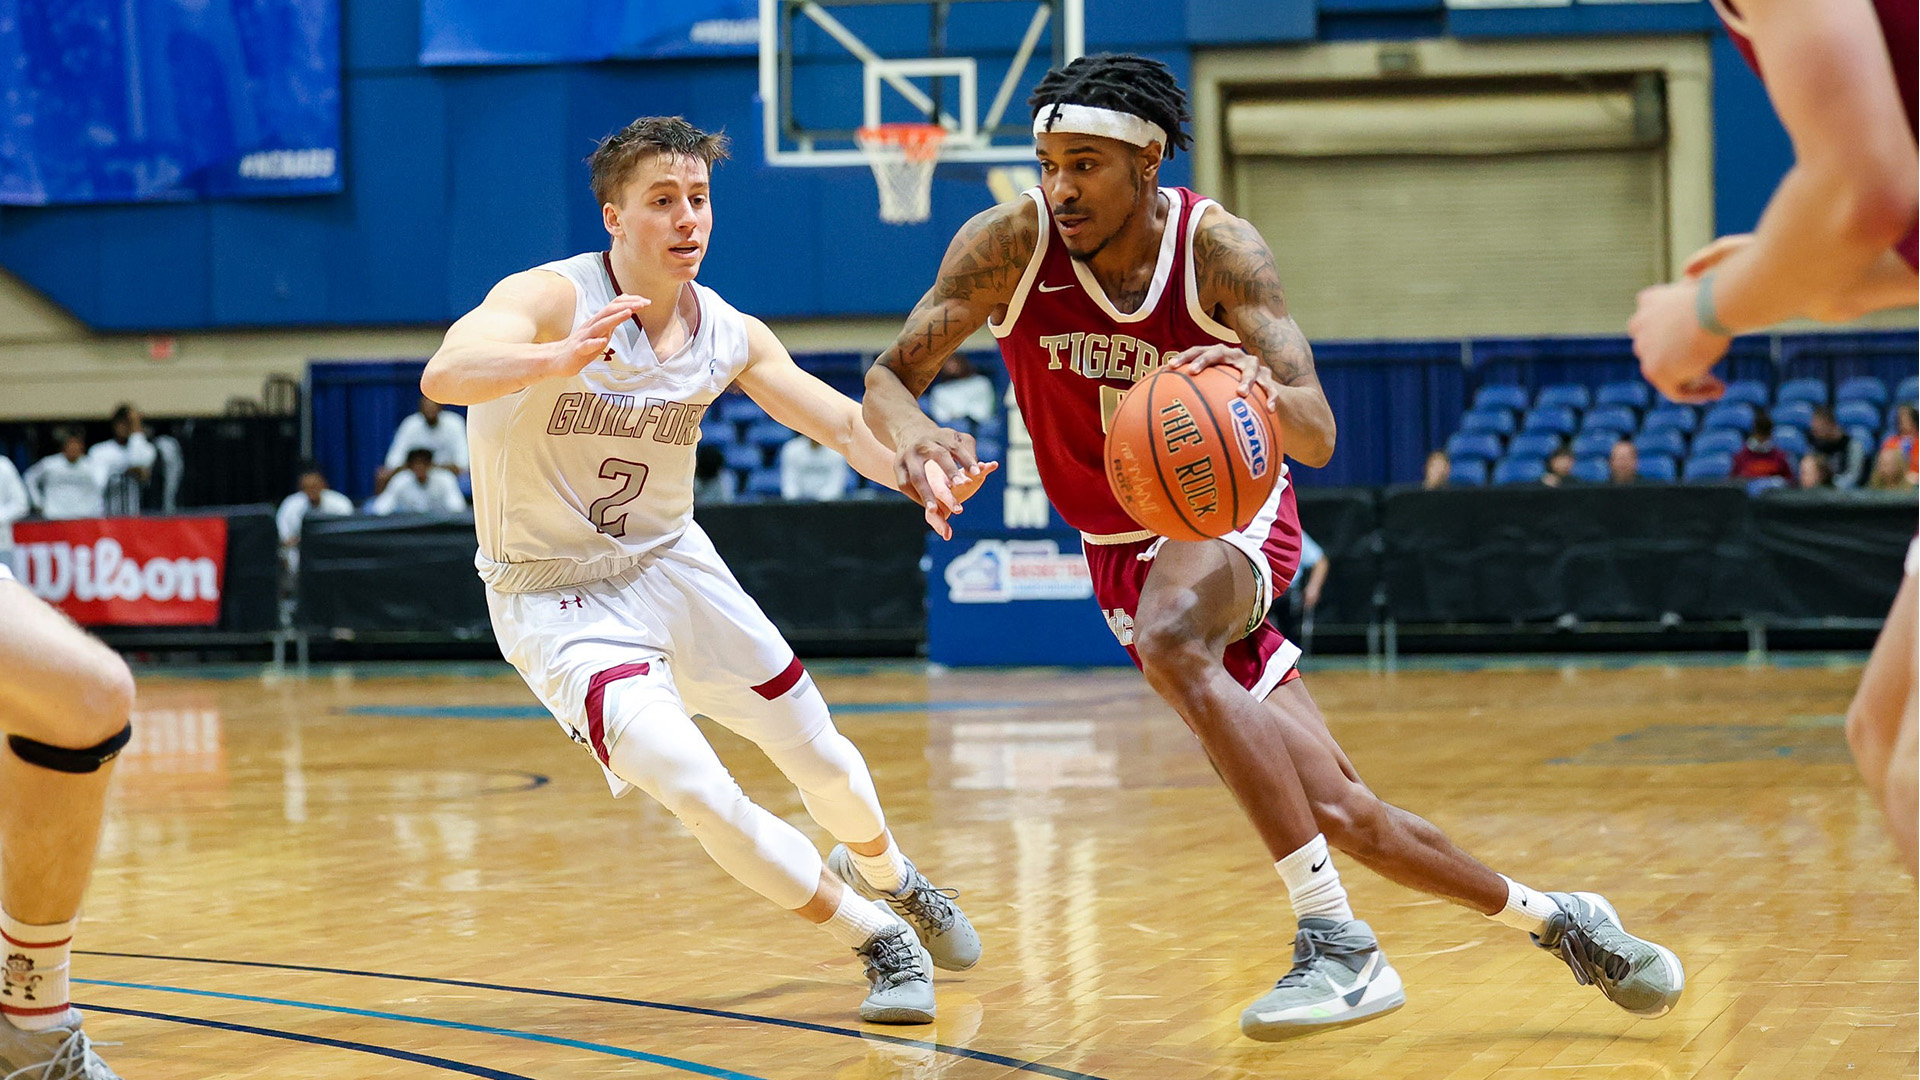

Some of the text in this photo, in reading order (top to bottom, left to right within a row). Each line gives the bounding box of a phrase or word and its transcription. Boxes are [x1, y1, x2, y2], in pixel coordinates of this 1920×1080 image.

[1160, 398, 1219, 520] THE ROCK
[1231, 399, 1267, 477] ODAC
[588, 457, 649, 538] 2
[13, 537, 220, 602] Wilson
